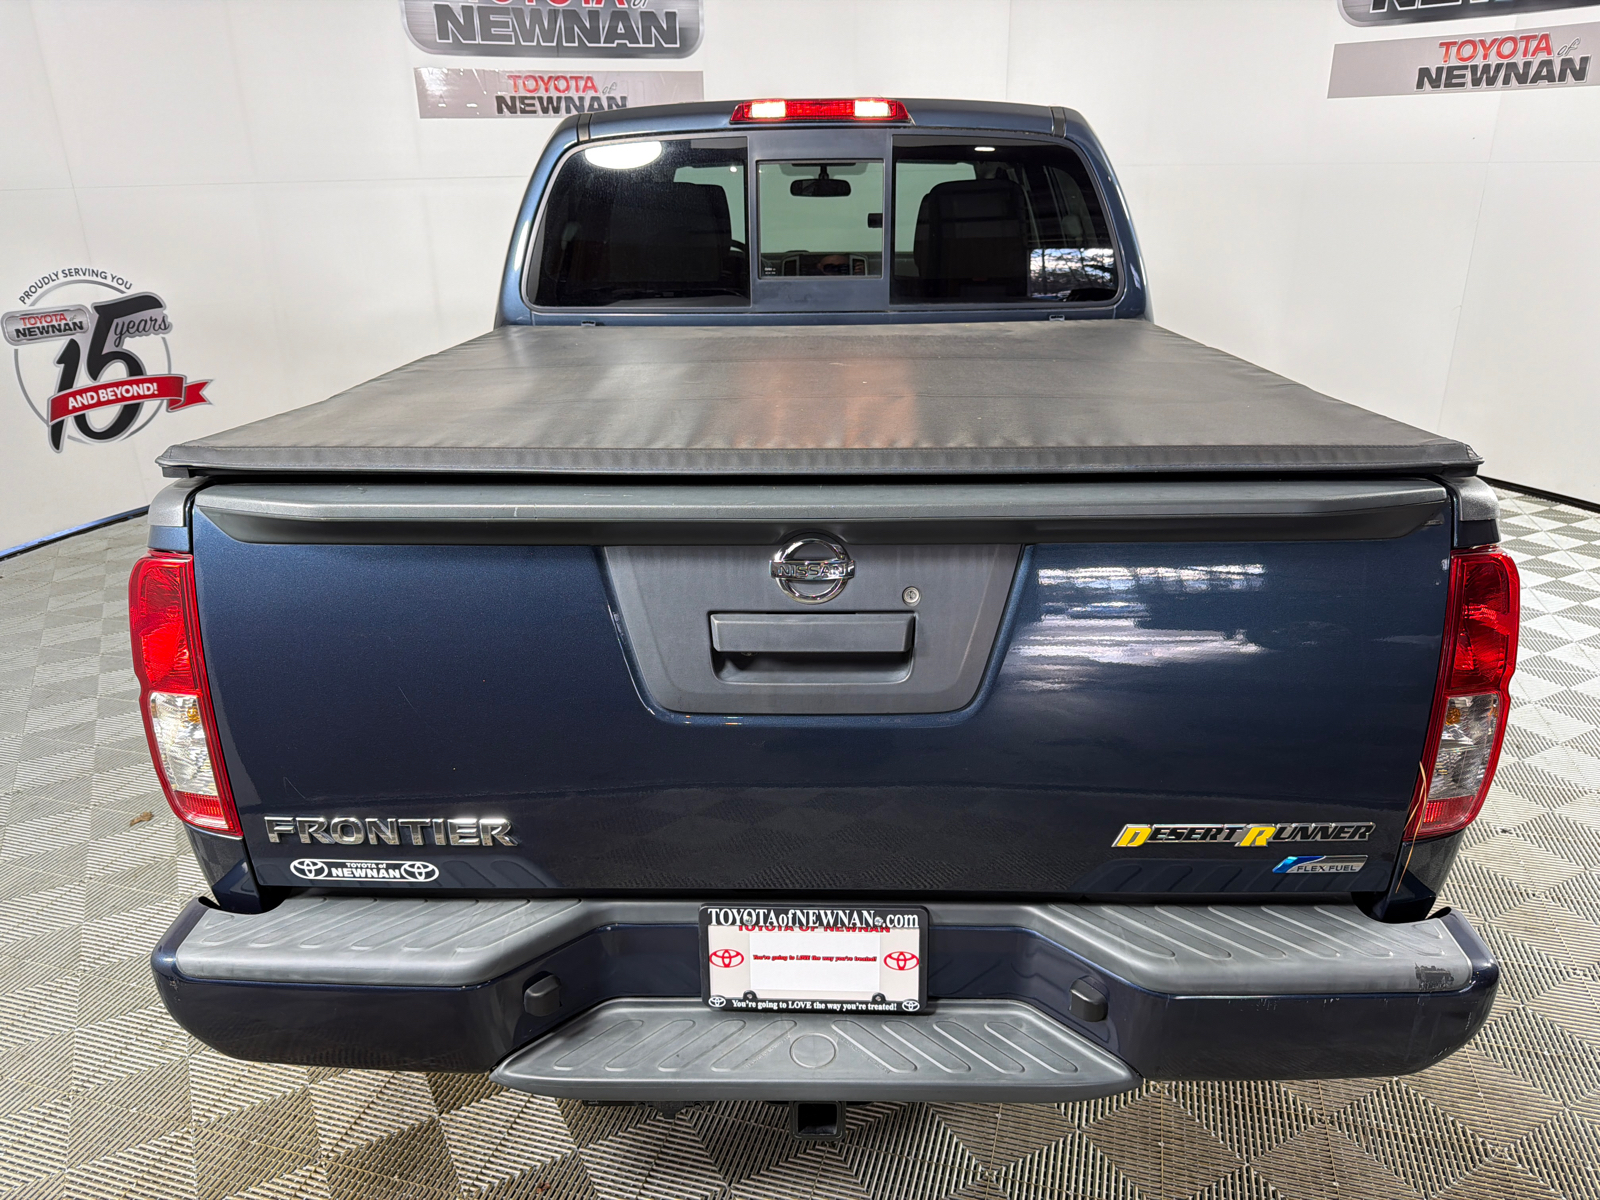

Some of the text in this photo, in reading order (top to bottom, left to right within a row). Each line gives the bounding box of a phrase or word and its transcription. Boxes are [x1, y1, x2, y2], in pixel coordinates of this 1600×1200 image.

[433, 4, 680, 47] NEWNAN
[1438, 33, 1581, 63] TOYOTA of
[507, 75, 599, 94] TOYOTA
[1415, 56, 1591, 90] NEWNAN
[495, 95, 628, 115] NEWNAN
[18, 267, 133, 305] PROUDLY SERVING YOU
[14, 321, 84, 339] NEWNAN
[19, 313, 68, 327] TOYOTA
[113, 313, 170, 348] years
[68, 382, 159, 410] AND BEYOND!
[778, 564, 846, 578] NISSAN
[264, 815, 519, 847] FRONTIER
[1111, 821, 1376, 847] DESERT RUNNER
[330, 867, 401, 879] NEWNAN
[1296, 864, 1358, 873] FLEX FUEL
[732, 1000, 756, 1009] You're
[757, 1002, 778, 1010] going
[788, 1001, 812, 1009] LOVE
[813, 1002, 826, 1010] the
[826, 1003, 842, 1011] way
[842, 1003, 867, 1011] you're
[867, 1003, 897, 1011] treated!
